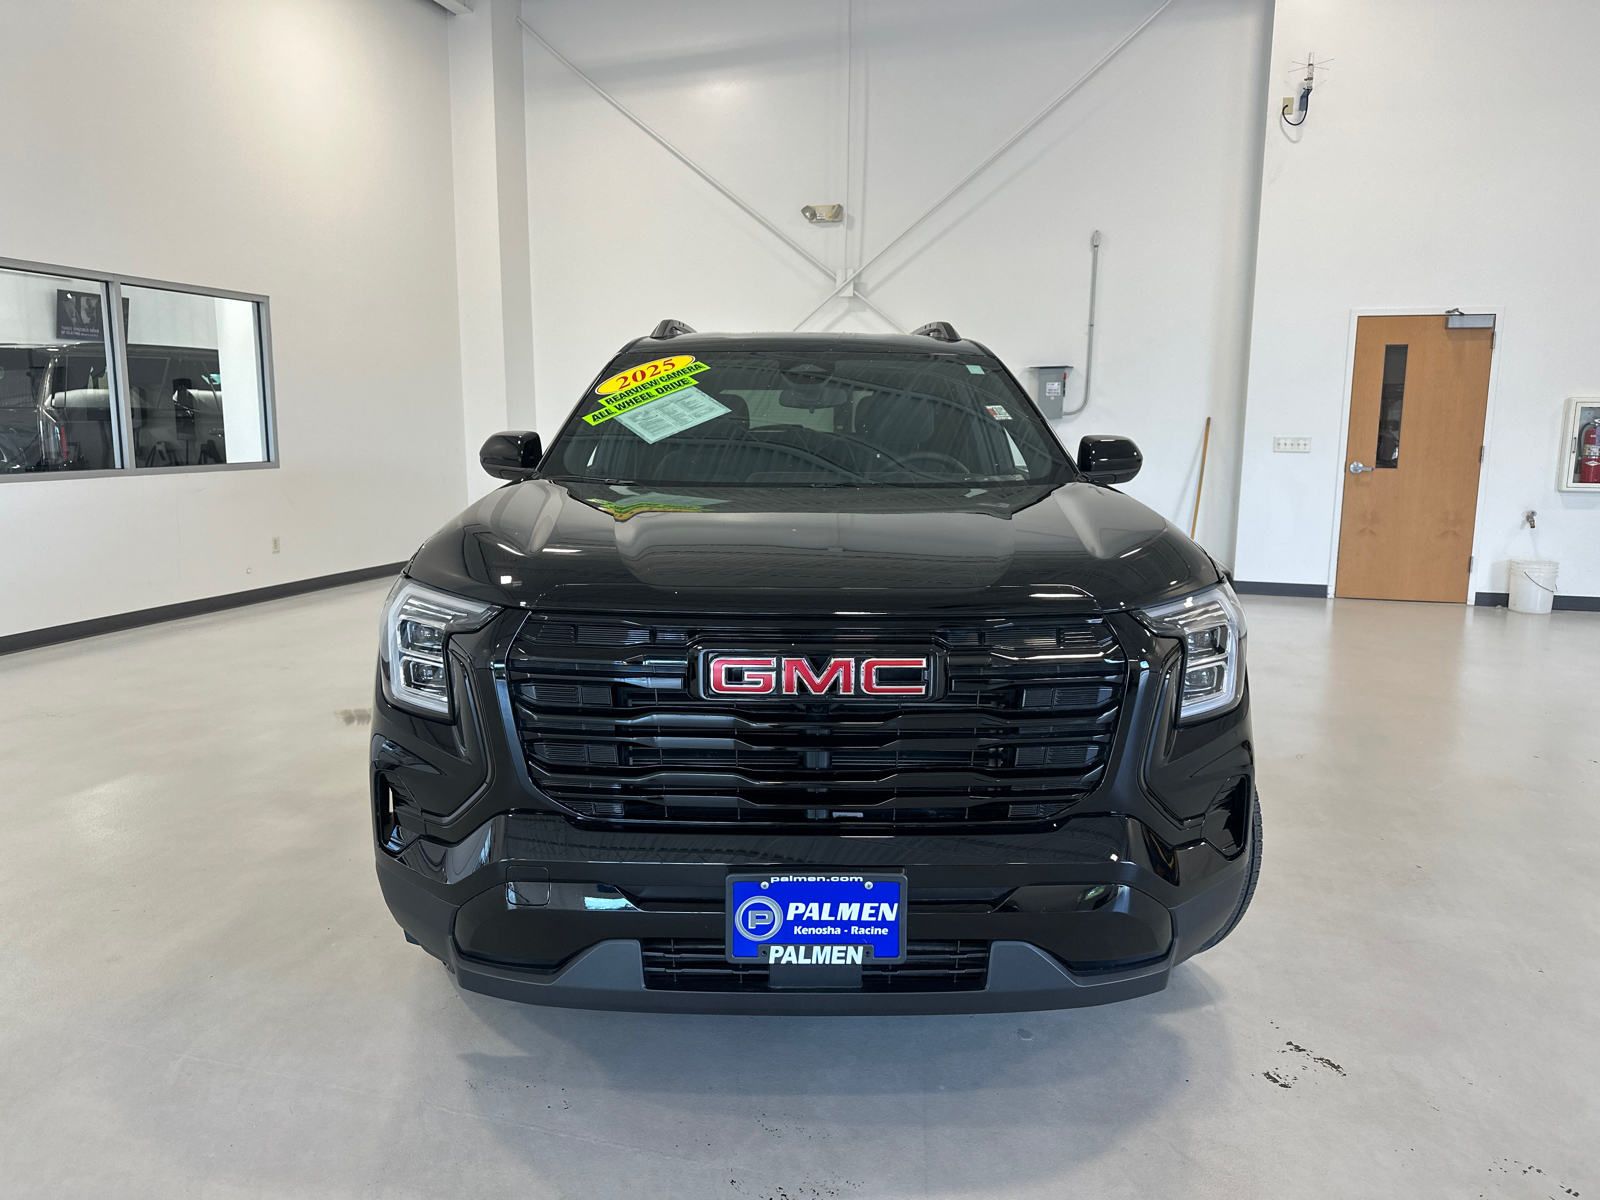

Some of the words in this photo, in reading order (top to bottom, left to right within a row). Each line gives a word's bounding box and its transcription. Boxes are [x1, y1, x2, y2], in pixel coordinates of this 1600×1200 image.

[604, 379, 657, 406] REARVIEW
[659, 363, 703, 382] CAMERA
[615, 358, 676, 390] 2025
[591, 406, 615, 422] ALL
[614, 391, 655, 411] WHEEL
[655, 378, 690, 395] DRIVE
[710, 657, 927, 695] GMC
[770, 875, 864, 883] palmen.com
[786, 902, 898, 921] PALMEN
[793, 925, 841, 935] Kenosha
[850, 925, 889, 935] Racine
[768, 945, 864, 965] PALMEN
